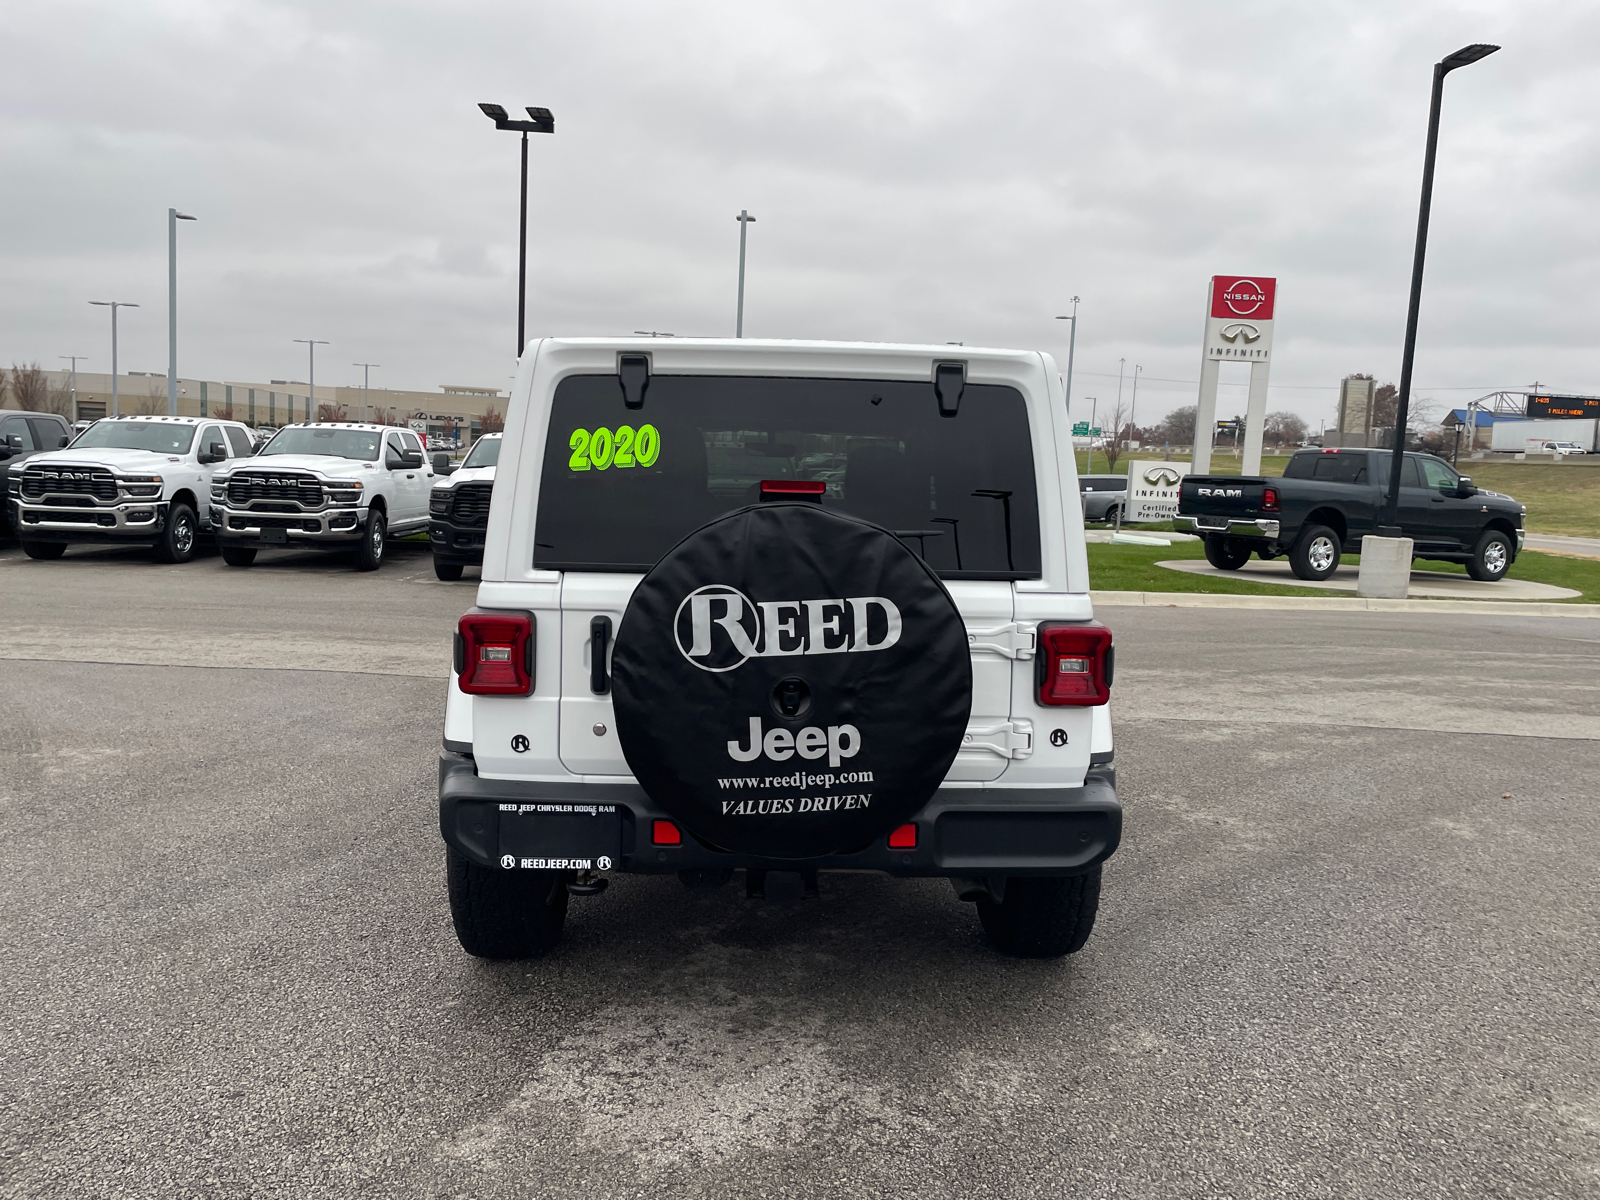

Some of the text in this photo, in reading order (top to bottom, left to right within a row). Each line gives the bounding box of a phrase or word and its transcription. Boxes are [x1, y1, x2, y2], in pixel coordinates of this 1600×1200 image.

[1223, 293, 1265, 301] NISSAN
[1210, 347, 1268, 357] INFINITI
[430, 414, 464, 422] LEXUS
[569, 423, 660, 471] 2020
[44, 472, 90, 480] RAM
[251, 478, 297, 486] RAM
[1136, 489, 1179, 498] INFINIT
[1197, 488, 1242, 498] RAM
[1142, 504, 1177, 512] Certified
[1137, 511, 1175, 519] Pre-Owne
[675, 588, 902, 668] REED
[727, 716, 862, 768] Jeep
[717, 770, 874, 790] www.reedjeep.com
[499, 803, 517, 811] REED
[520, 804, 536, 812] JEEP
[537, 804, 573, 812] CHRYSLER
[574, 805, 597, 813] DODGE
[721, 793, 873, 816] VALUES DRIVEN
[521, 858, 591, 869] REEDJEEP.COM
